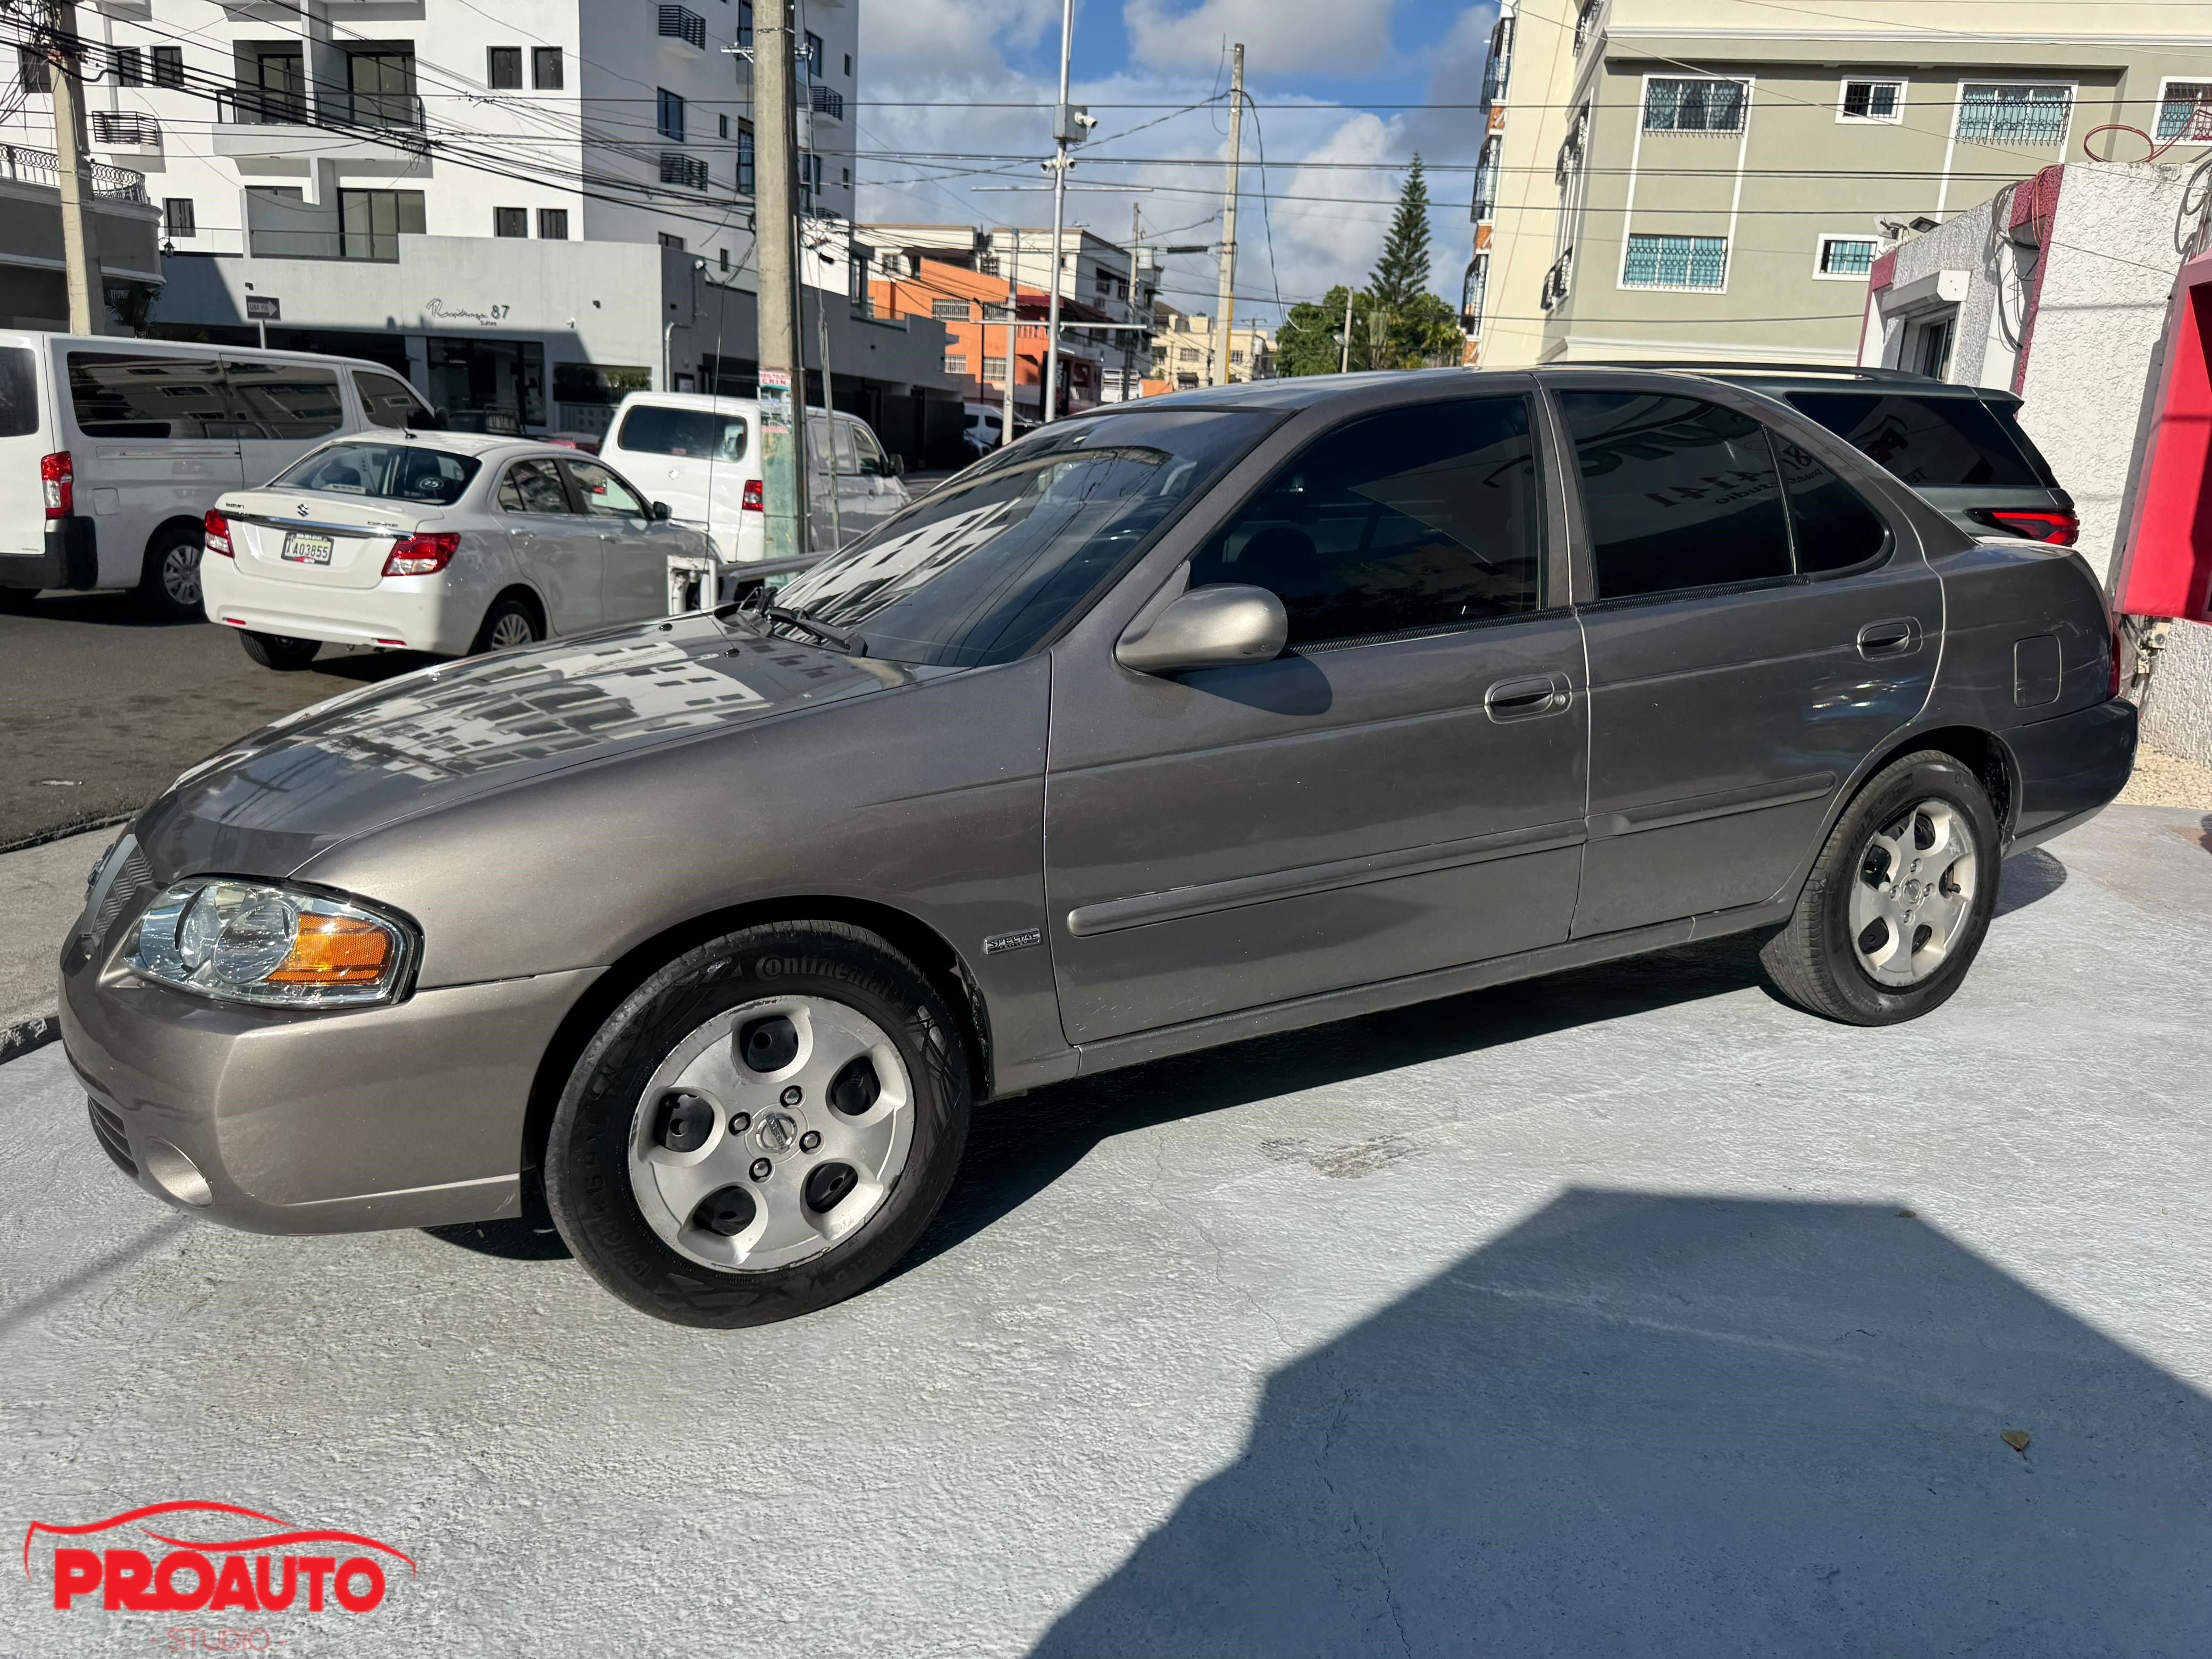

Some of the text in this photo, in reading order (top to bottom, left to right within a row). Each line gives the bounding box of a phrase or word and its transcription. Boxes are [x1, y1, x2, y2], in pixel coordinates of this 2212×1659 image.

[491, 305, 510, 319] 87
[987, 930, 1040, 948] SPECIAL
[756, 954, 895, 1000] Continental
